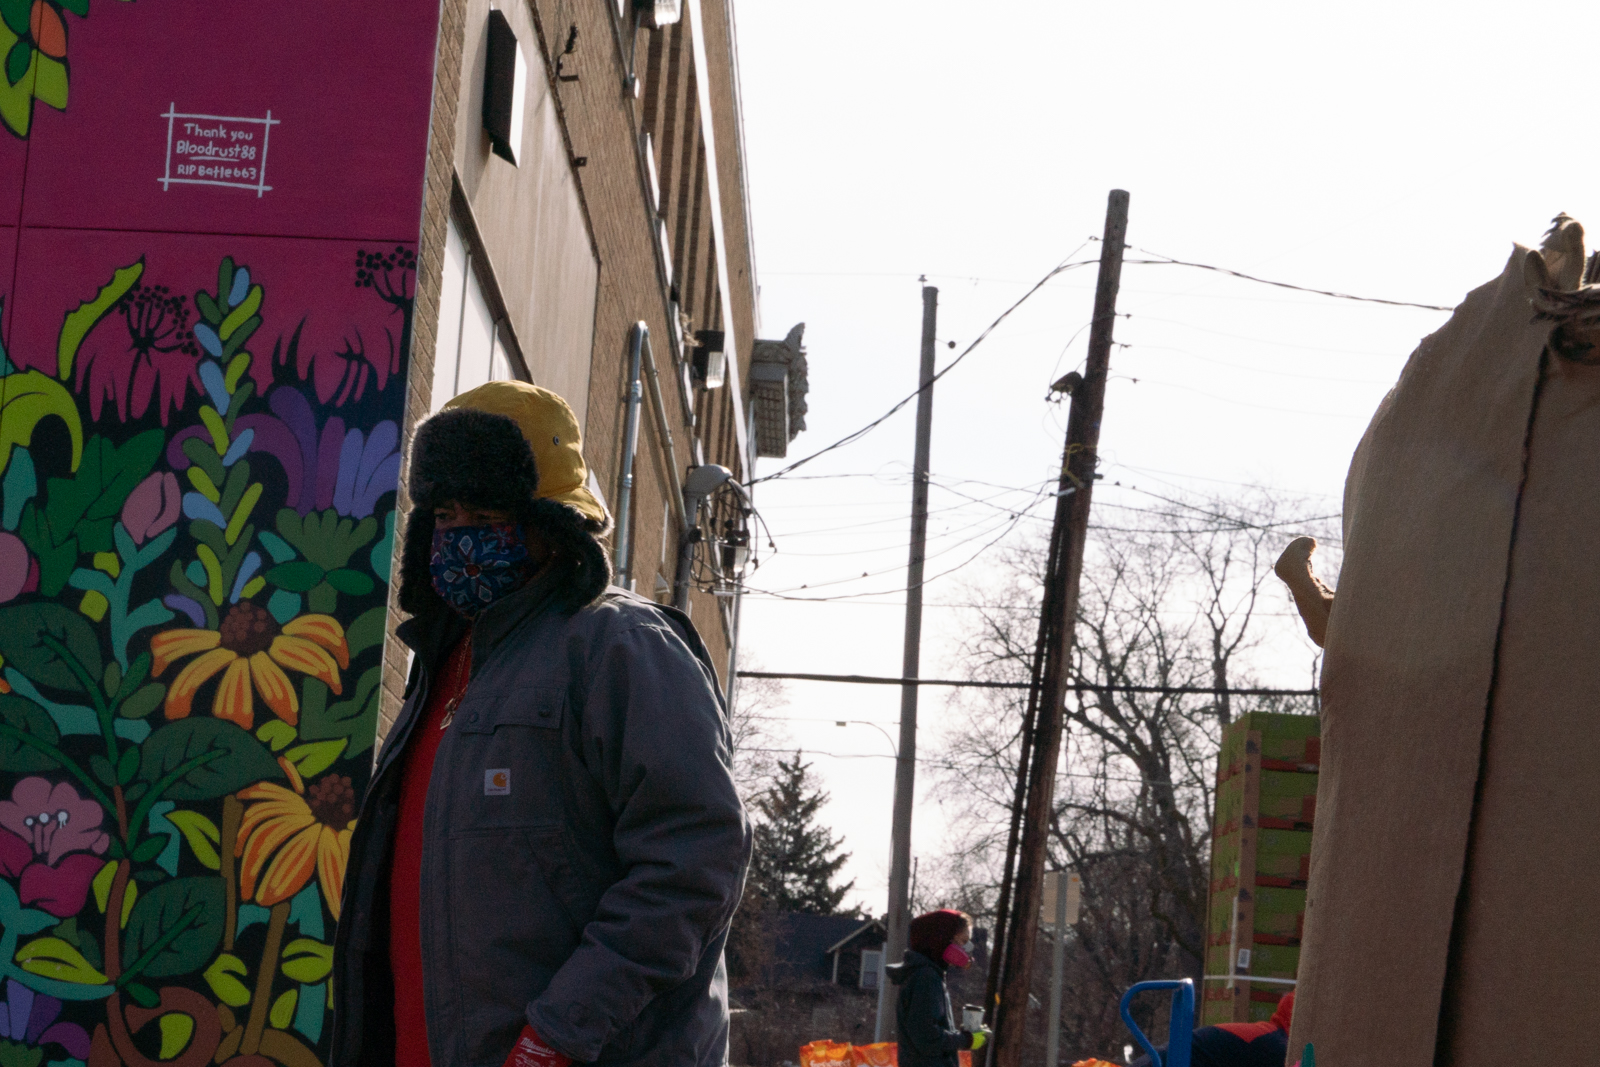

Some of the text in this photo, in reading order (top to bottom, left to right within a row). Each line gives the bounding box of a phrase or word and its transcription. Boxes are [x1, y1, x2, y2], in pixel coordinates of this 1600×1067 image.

[184, 123, 253, 141] Thank you
[176, 140, 256, 160] Bloodrust88
[177, 164, 196, 176] RIP
